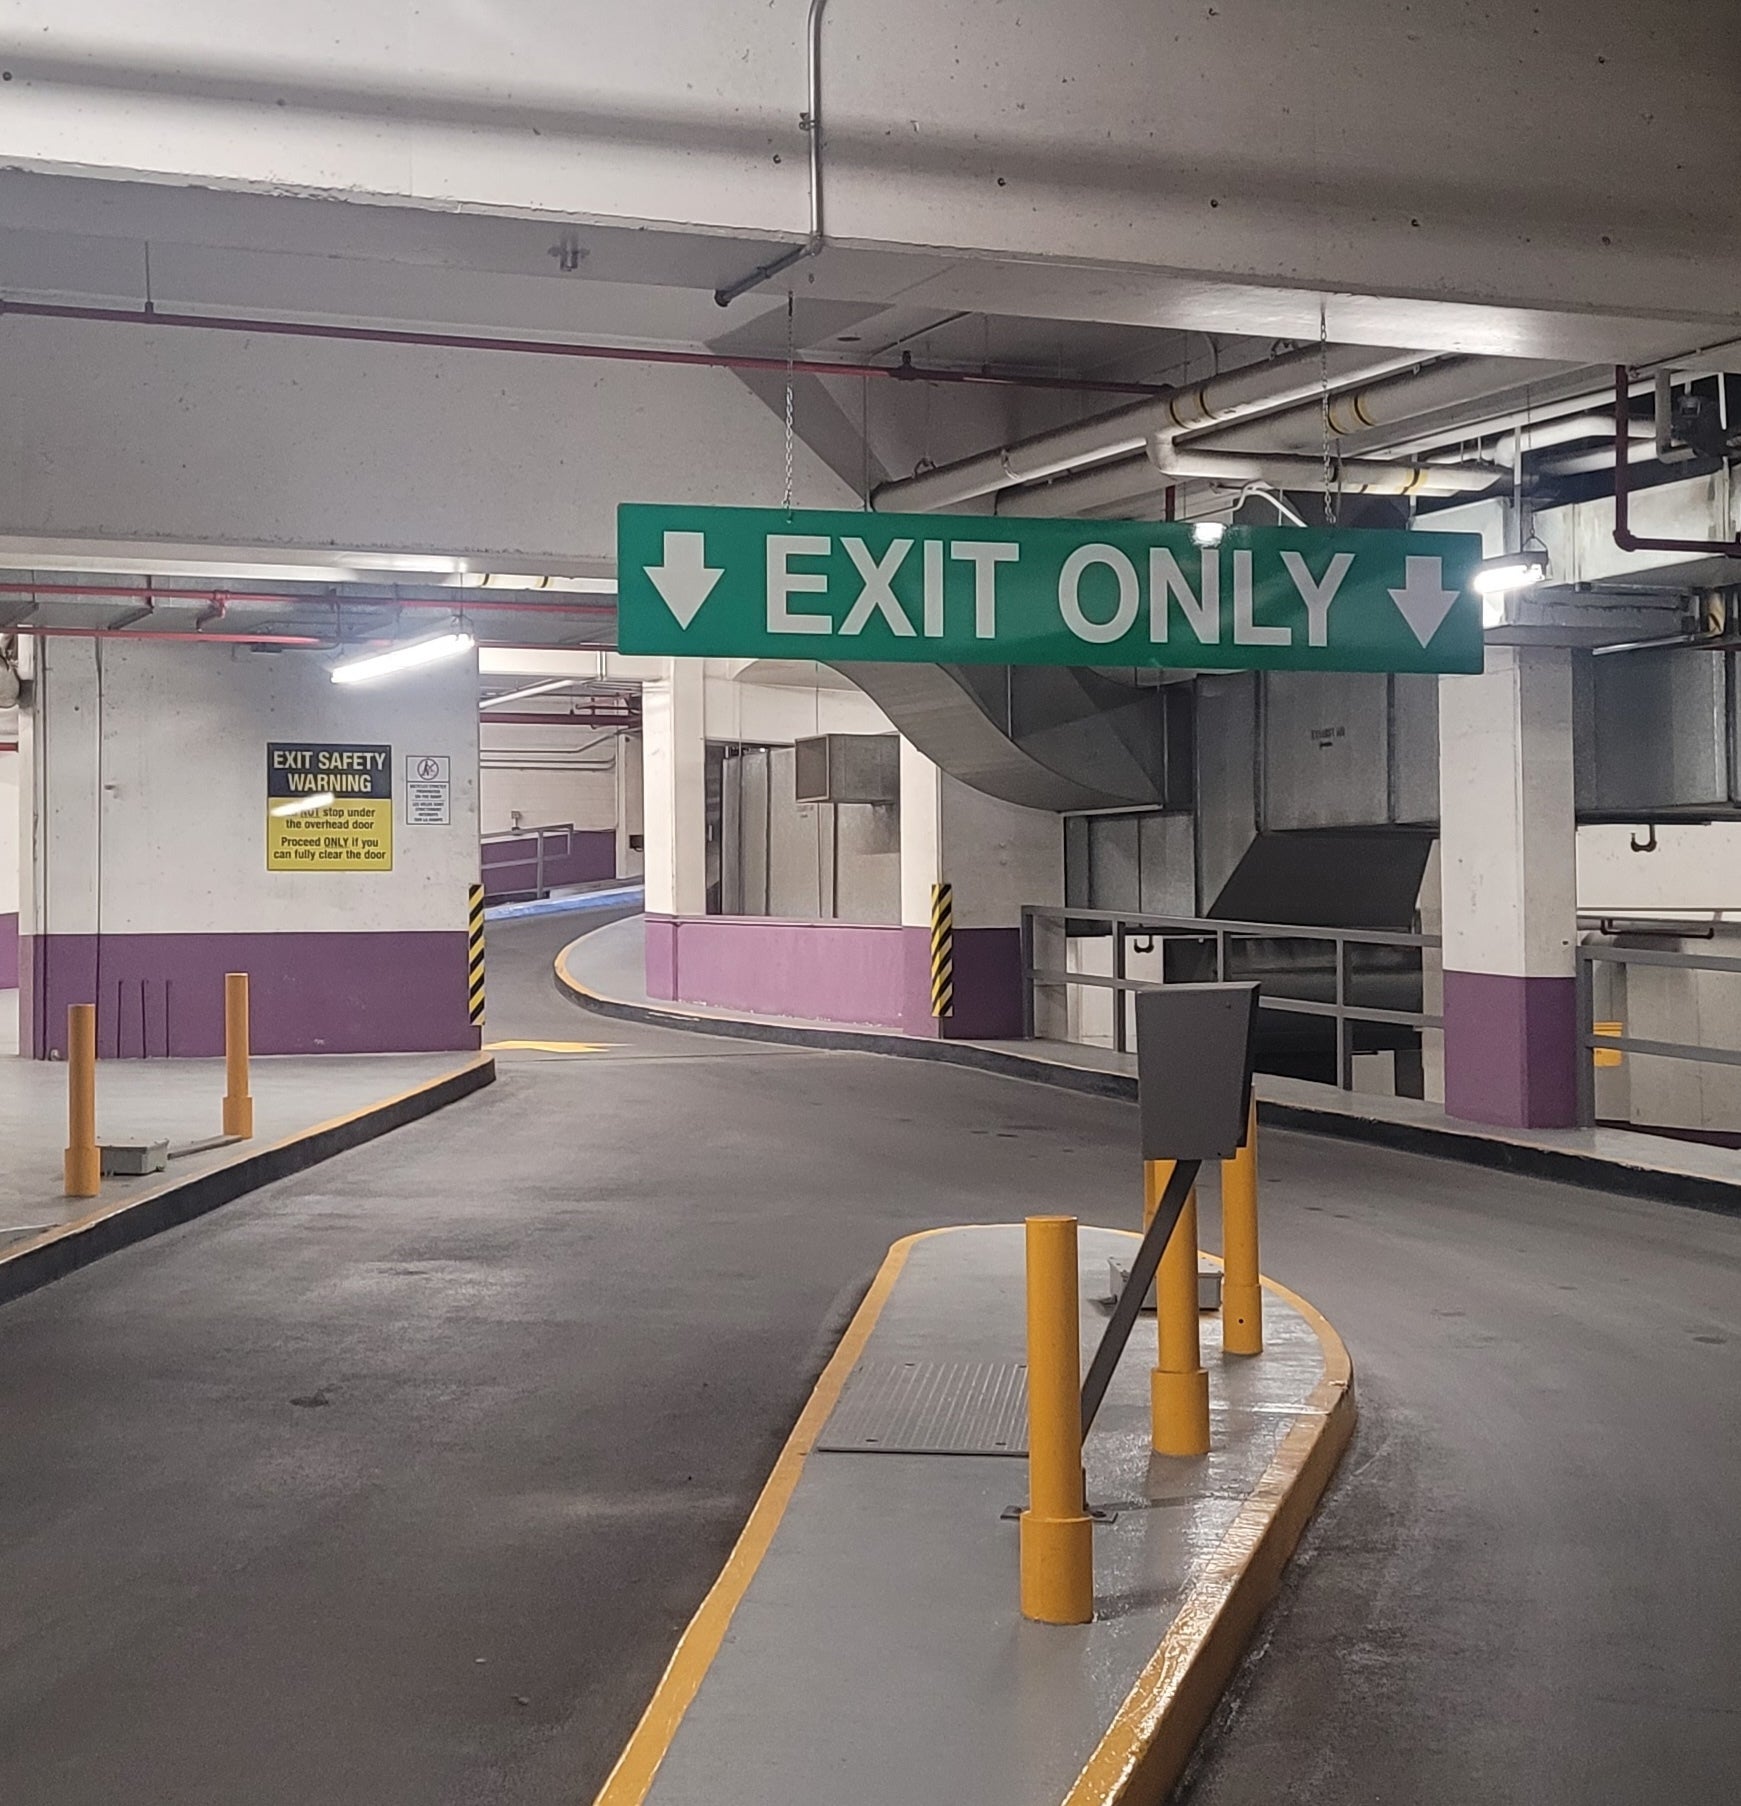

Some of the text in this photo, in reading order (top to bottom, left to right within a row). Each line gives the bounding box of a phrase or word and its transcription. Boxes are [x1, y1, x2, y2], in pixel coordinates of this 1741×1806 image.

[766, 534, 1356, 647] EXIT ONLY
[273, 750, 386, 770] EXIT SAFETY
[287, 773, 372, 792] WARNING
[323, 807, 345, 818] stop
[347, 808, 376, 817] under
[286, 819, 375, 829] the overhead door
[281, 837, 379, 849] Proceed ONLY if you
[273, 849, 386, 861] can fully clear the door
